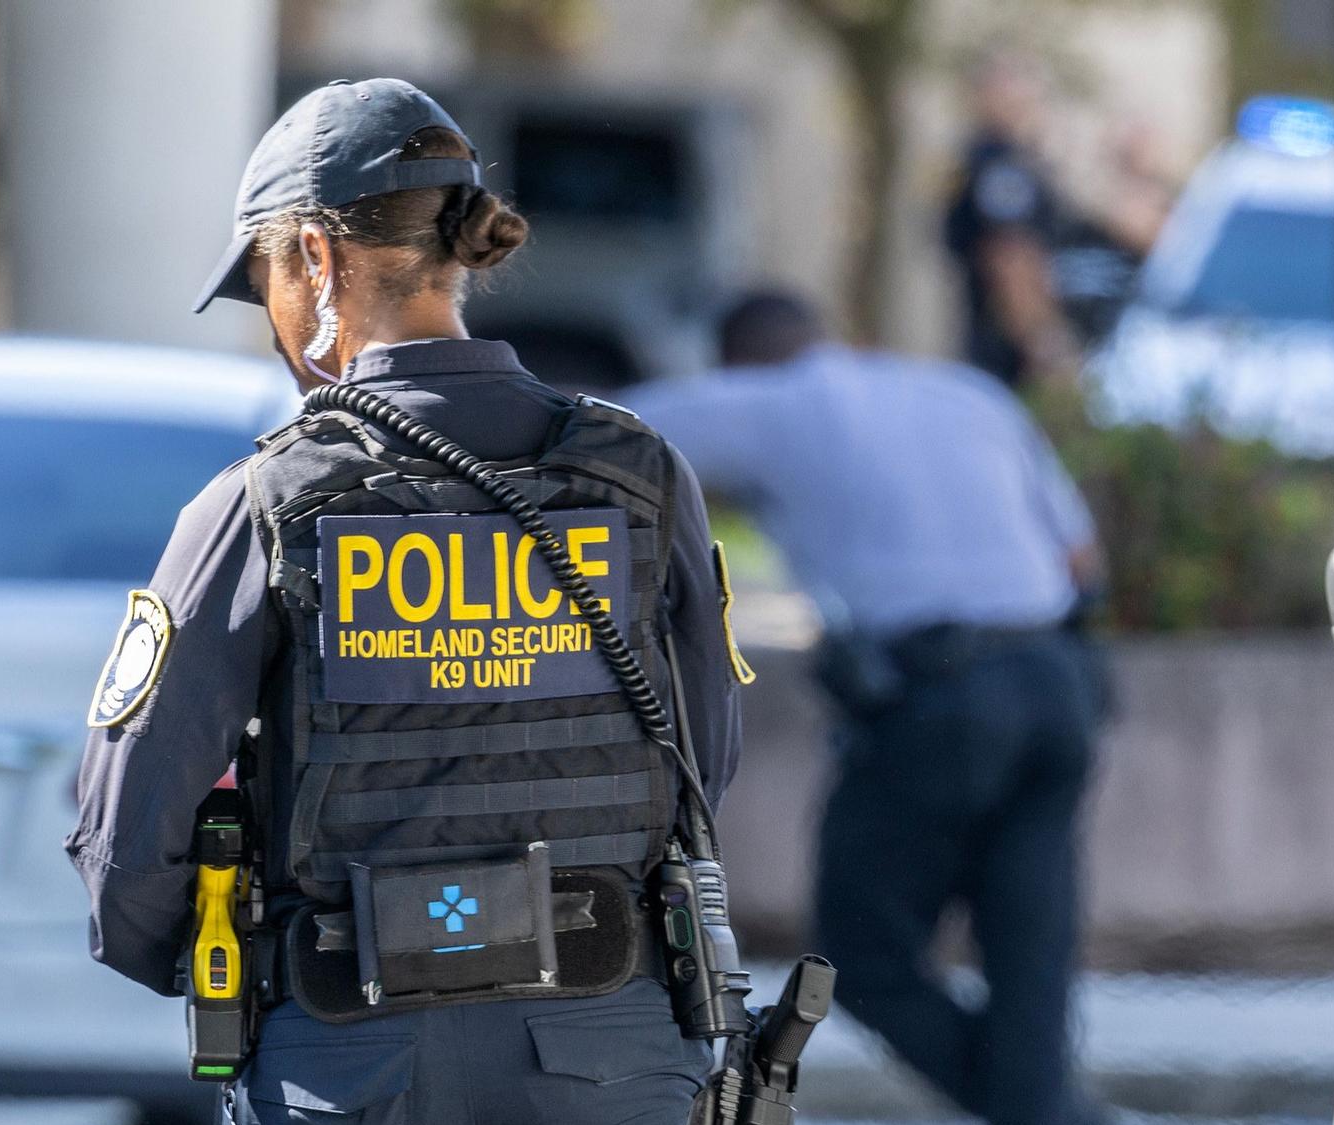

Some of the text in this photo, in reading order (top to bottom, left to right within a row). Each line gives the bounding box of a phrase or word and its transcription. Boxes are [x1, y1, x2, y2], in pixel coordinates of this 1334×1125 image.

[338, 527, 610, 623] POLICE
[338, 623, 592, 659] HOMELAND SECURIT
[430, 658, 536, 689] K9 UNIT
